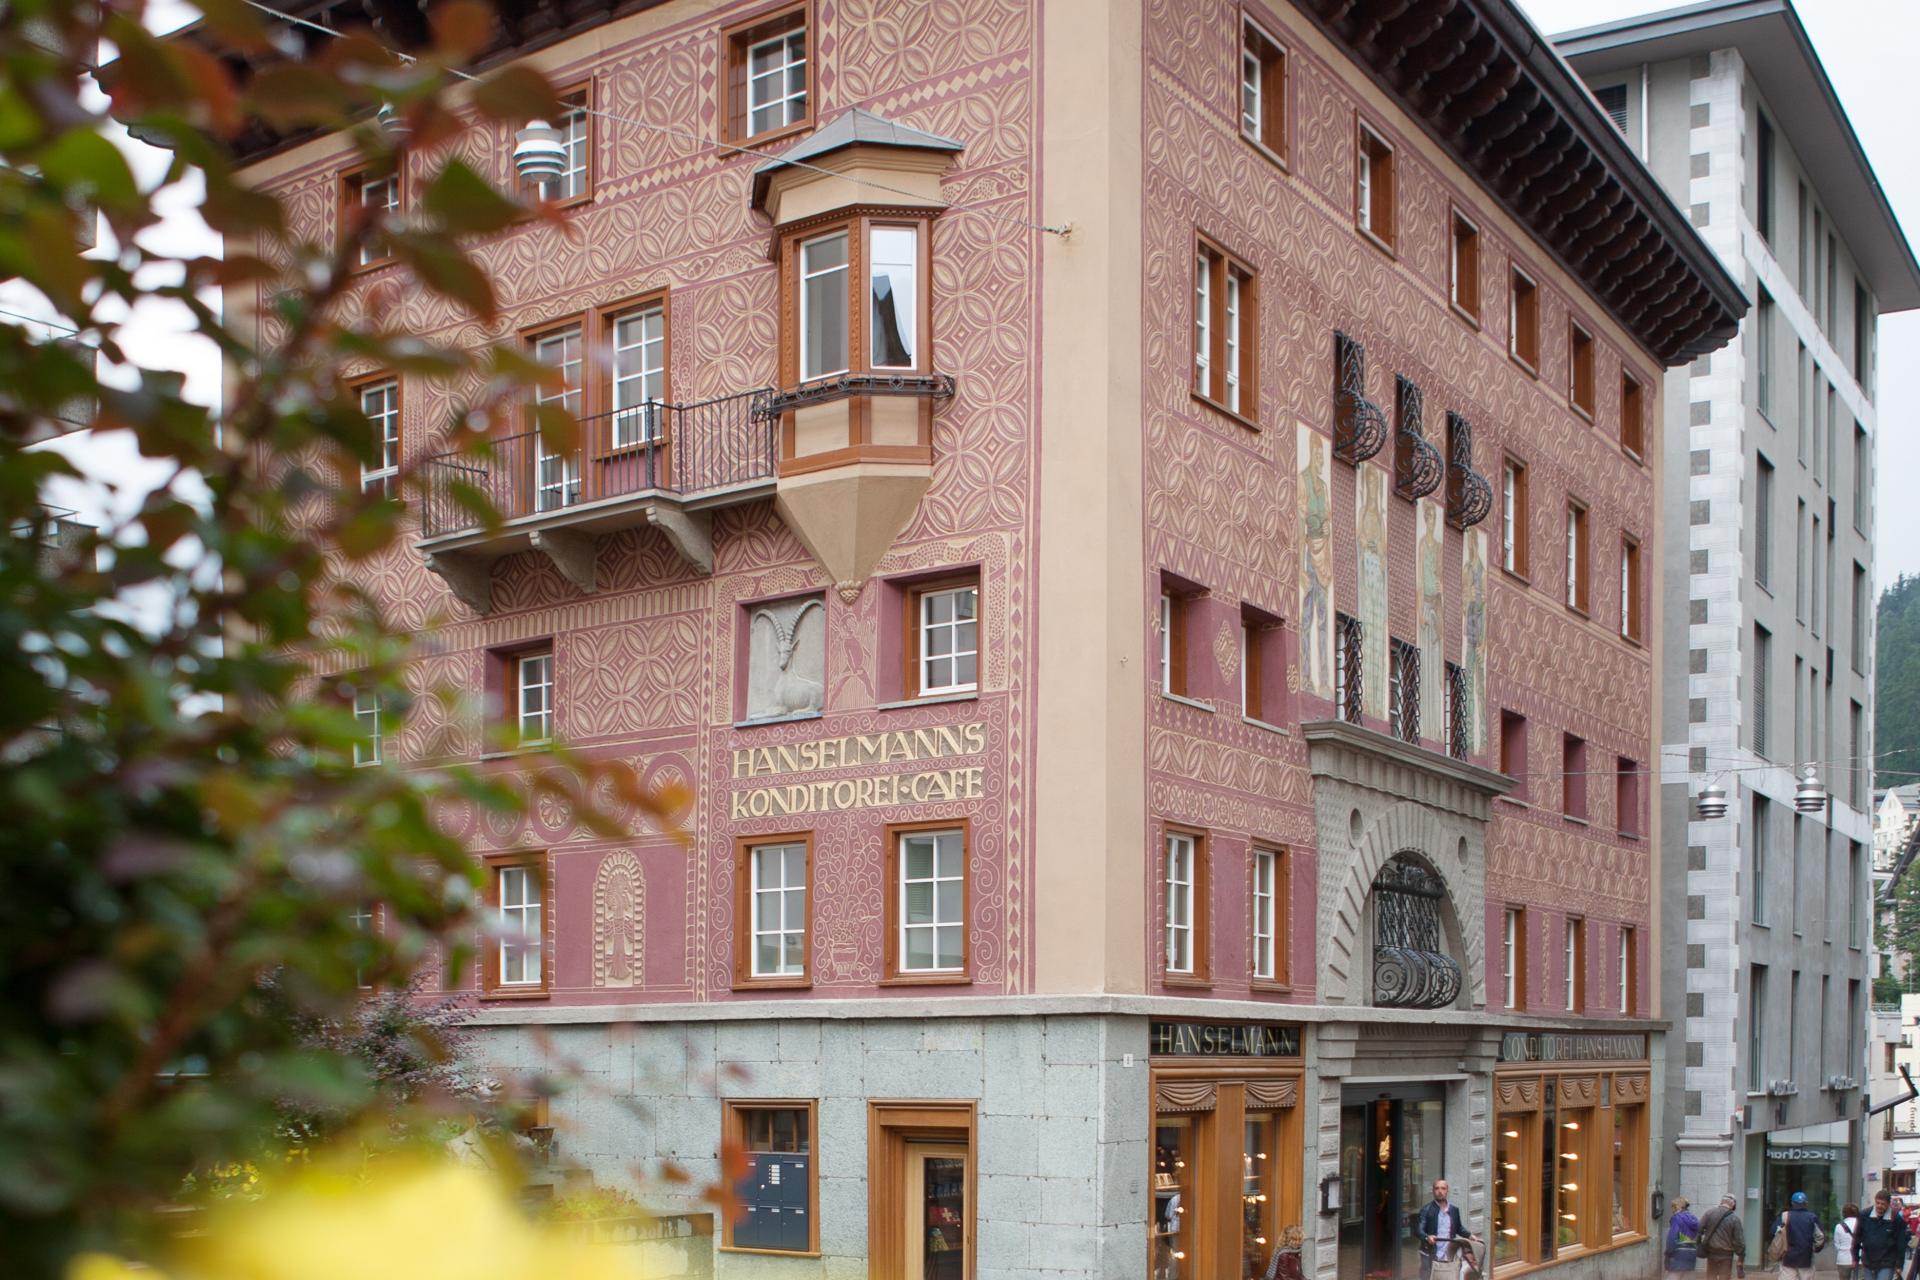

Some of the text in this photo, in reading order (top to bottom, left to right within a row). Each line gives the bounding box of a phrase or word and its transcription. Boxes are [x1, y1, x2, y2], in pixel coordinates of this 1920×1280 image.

[731, 722, 986, 778] HANSELMANNS
[1159, 1025, 1293, 1055] HANSELMANN
[1503, 1036, 1641, 1061] CONDITOREI HANSELMANN
